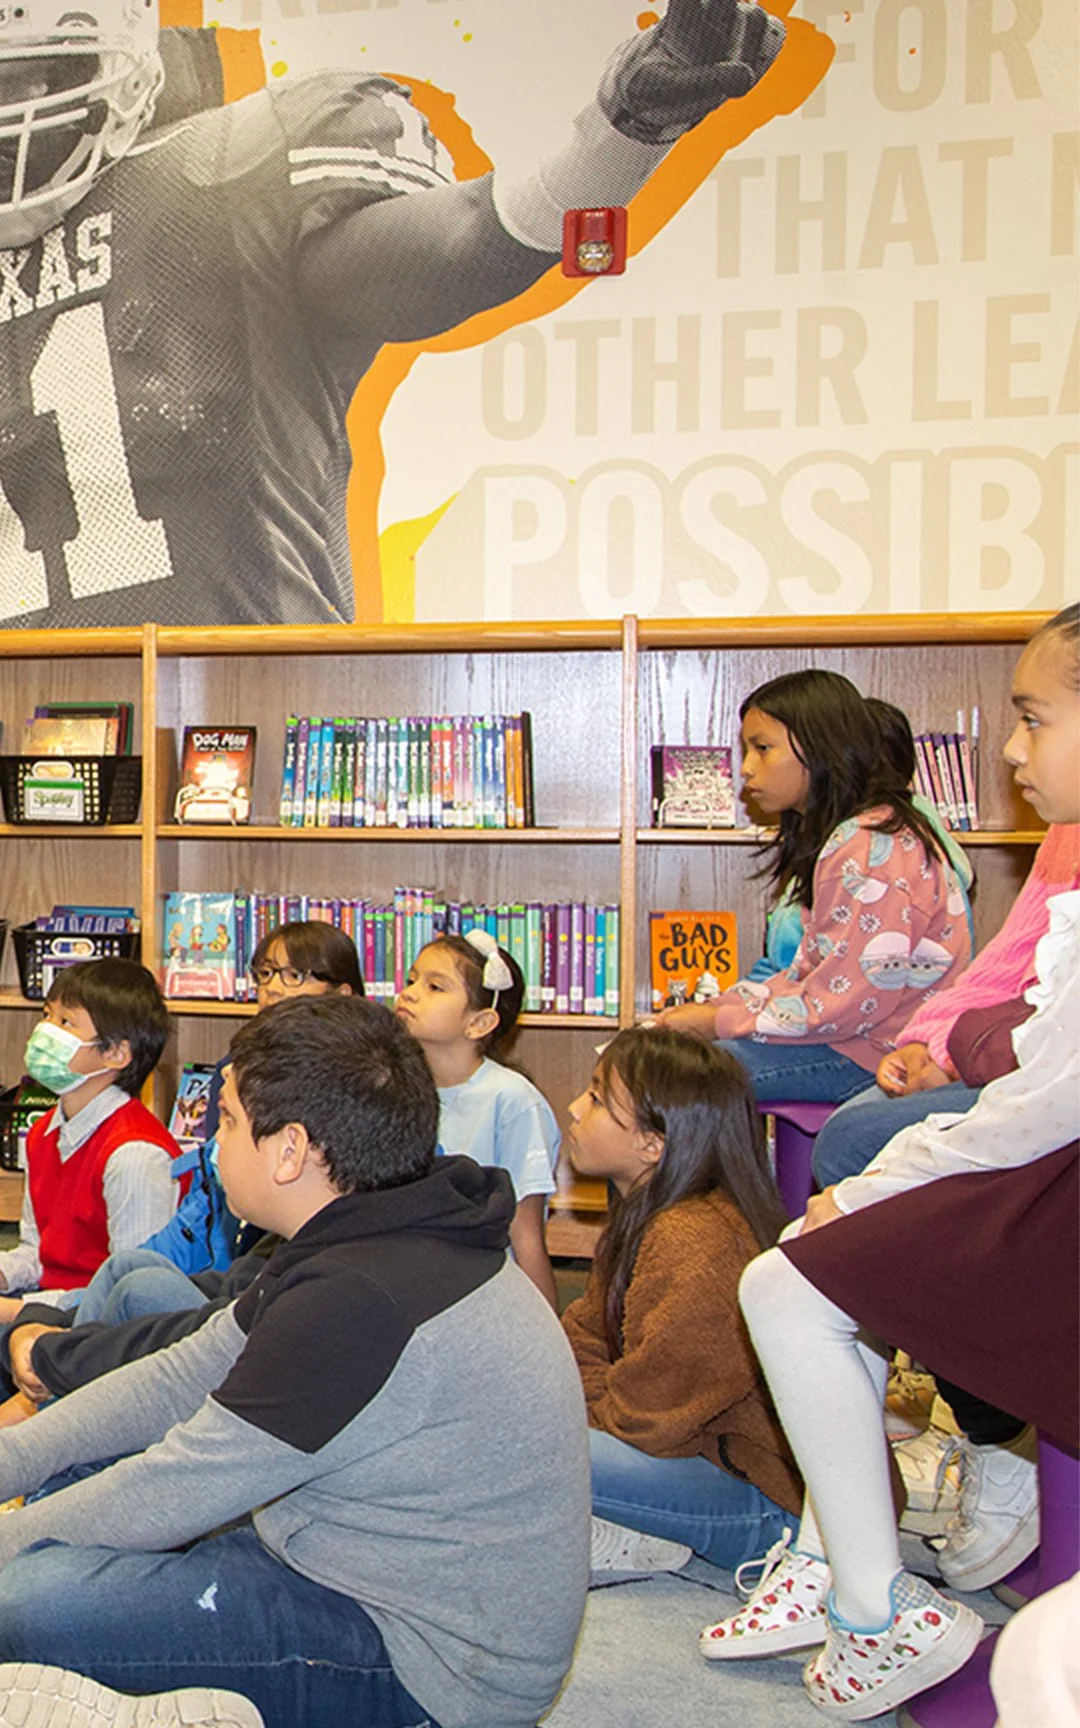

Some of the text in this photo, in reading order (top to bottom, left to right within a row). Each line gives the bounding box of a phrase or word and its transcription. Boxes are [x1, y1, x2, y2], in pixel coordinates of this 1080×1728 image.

[801, 0, 1044, 120] FOR
[709, 136, 1014, 279] THAT
[481, 305, 869, 441] OTHER
[192, 733, 248, 747] DOG MAN
[659, 945, 731, 974] GUYS
[671, 922, 728, 947] BAD
